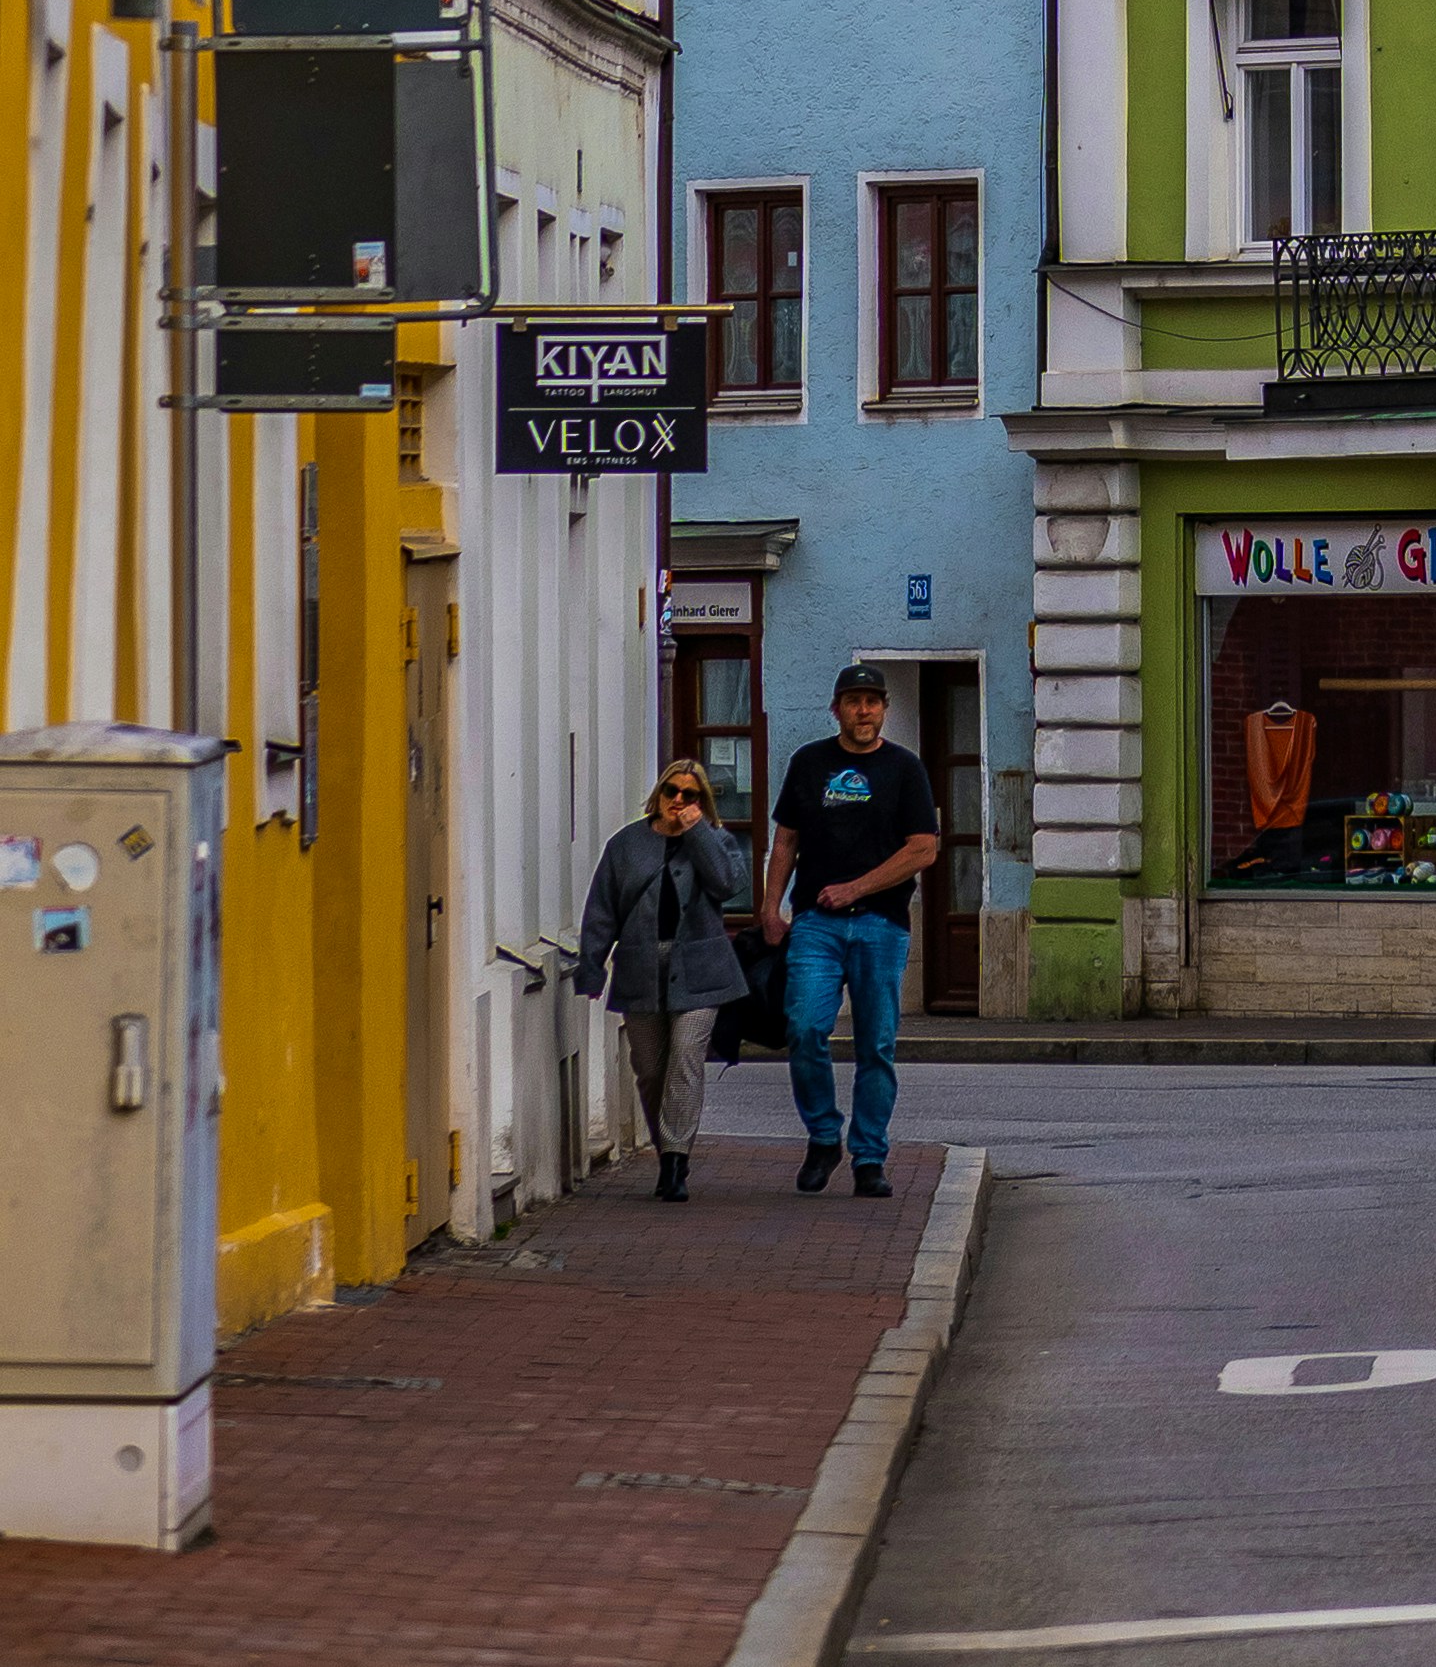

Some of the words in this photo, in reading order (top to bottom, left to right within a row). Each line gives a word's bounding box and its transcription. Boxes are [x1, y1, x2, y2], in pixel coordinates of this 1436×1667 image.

[536, 343, 667, 398] KIYAN
[544, 388, 585, 397] TATTOO
[603, 388, 658, 397] LANDSHUT
[528, 413, 676, 459] VELOX
[595, 457, 638, 465] FITNESS
[1221, 528, 1334, 587] WOLLE
[909, 579, 928, 600] 563
[671, 604, 706, 617] inhard
[709, 604, 740, 617] Gierer
